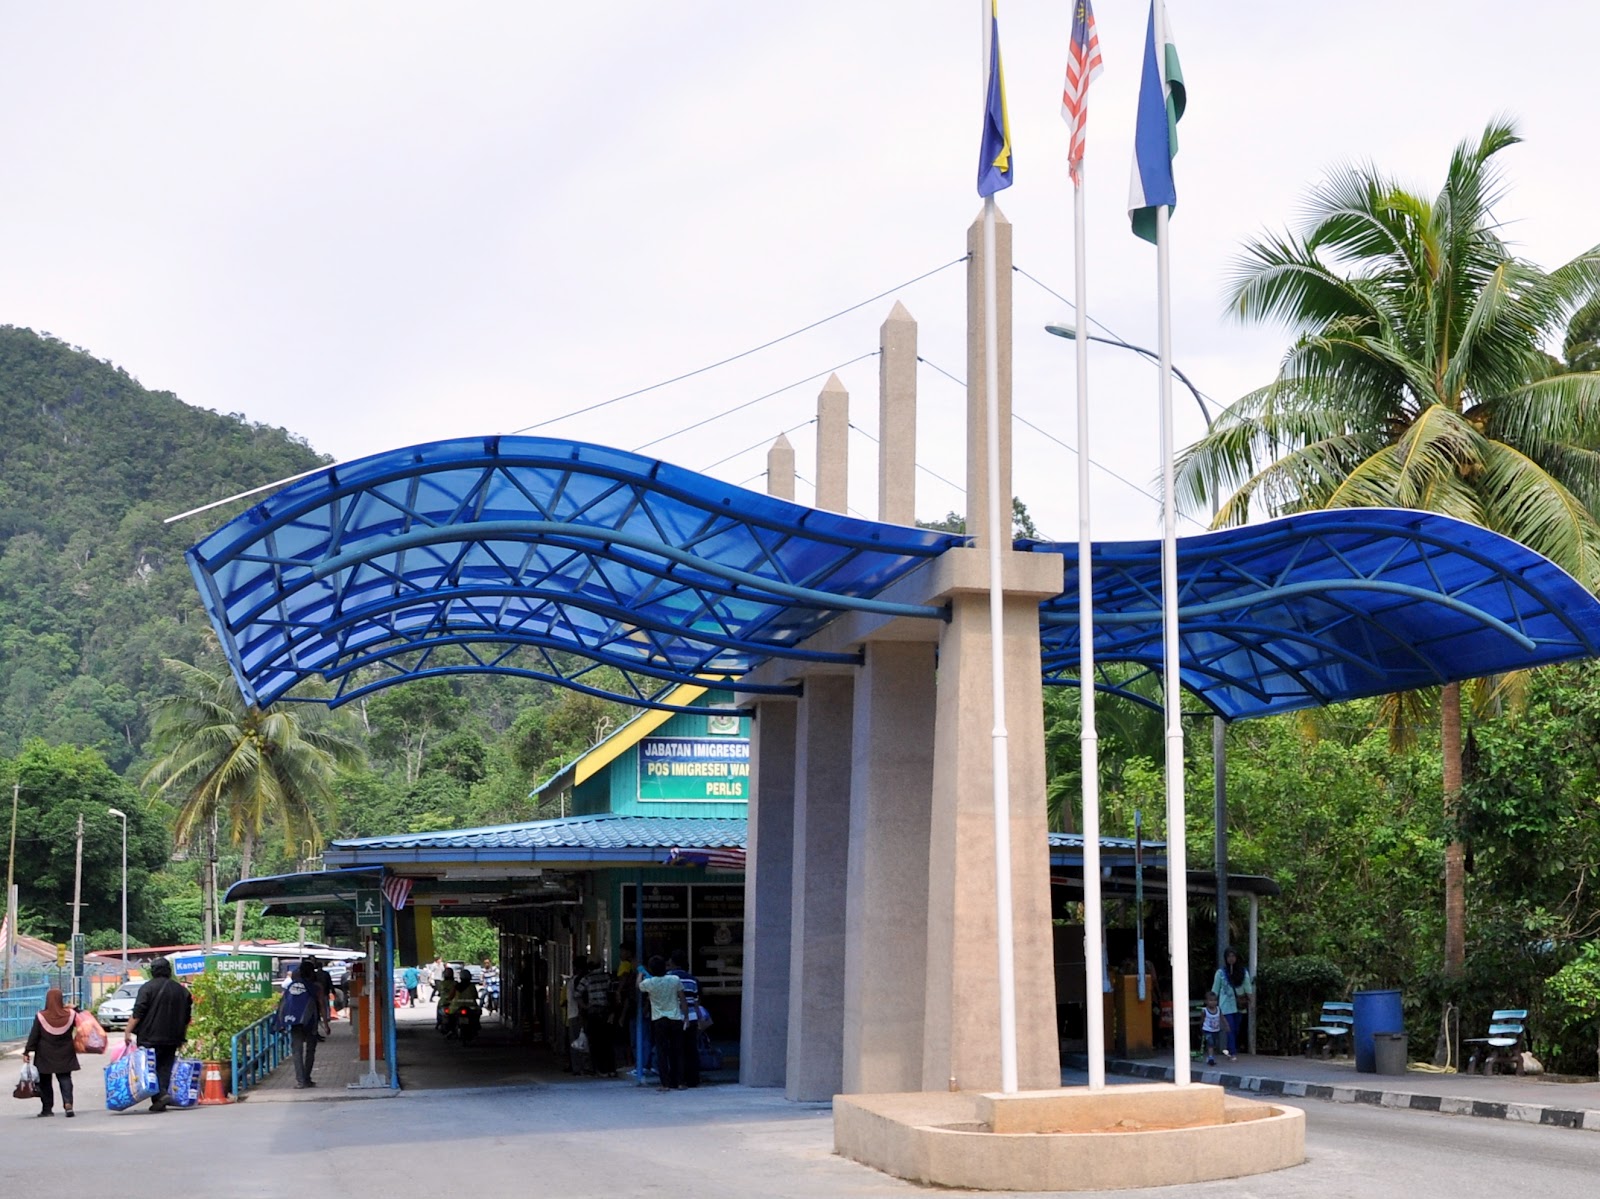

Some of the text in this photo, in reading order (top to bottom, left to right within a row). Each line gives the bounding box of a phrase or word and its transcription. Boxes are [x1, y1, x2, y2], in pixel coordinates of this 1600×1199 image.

[644, 743, 750, 758] JABATAN IMIGRESEN
[648, 763, 670, 776] POS
[671, 763, 728, 777] IMIGRESEN
[706, 782, 742, 796] PERLIS
[217, 960, 260, 971] BERHENTI
[218, 972, 270, 982] IKSAAN
